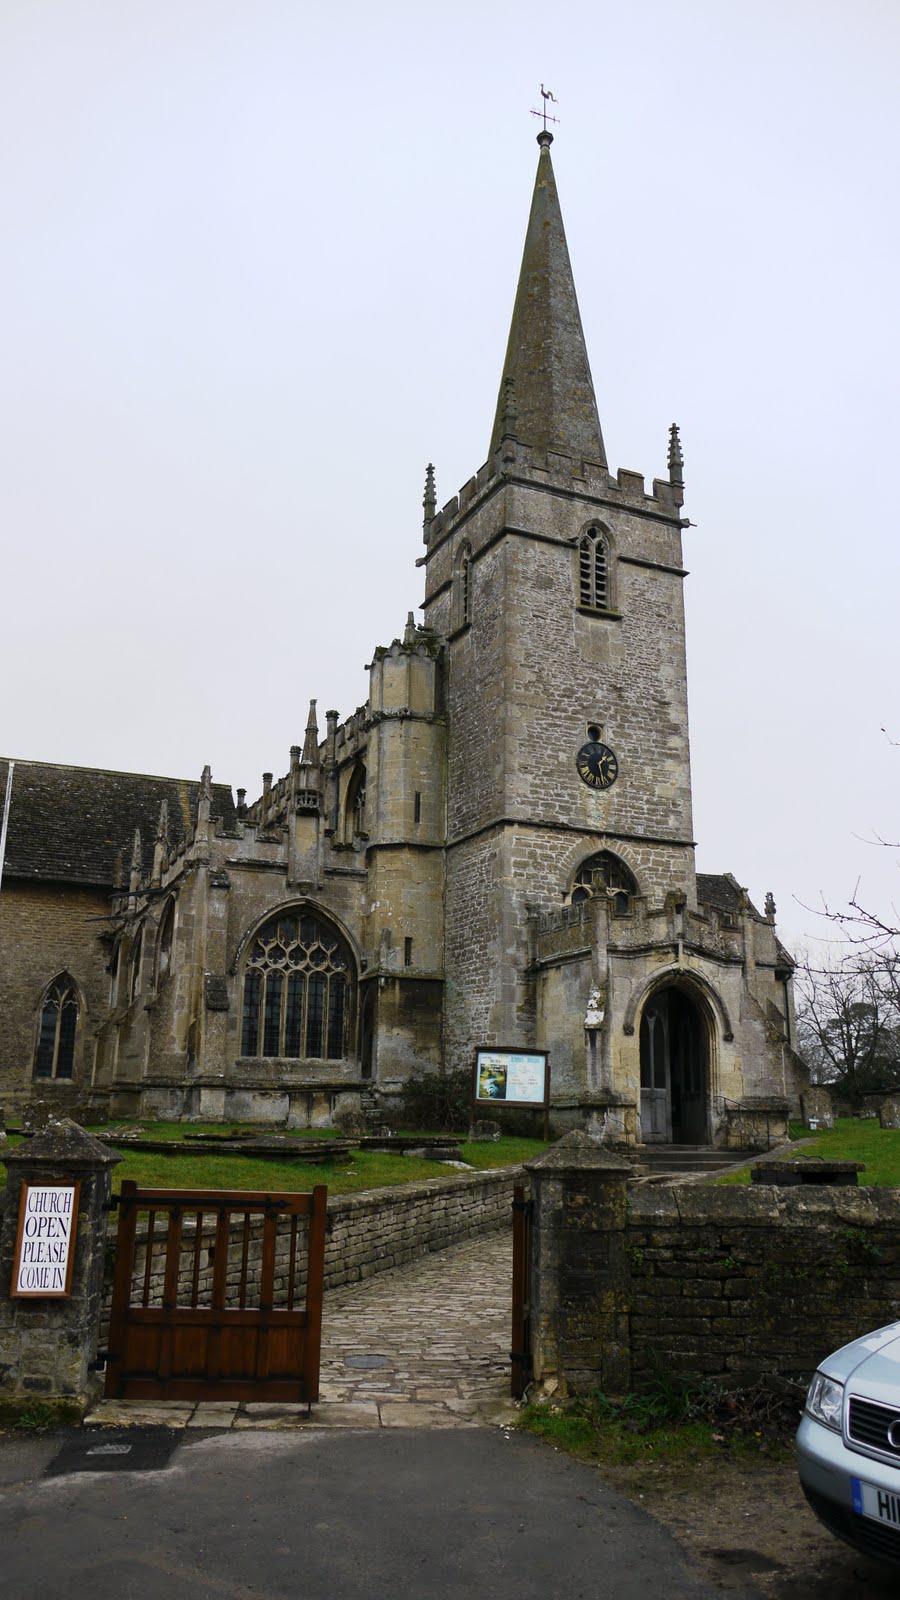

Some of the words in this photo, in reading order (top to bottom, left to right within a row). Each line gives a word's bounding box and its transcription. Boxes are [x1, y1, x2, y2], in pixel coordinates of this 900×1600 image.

[28, 1192, 72, 1213] CHURCH
[25, 1216, 69, 1237] OPEN
[22, 1241, 67, 1263] PLEASE
[20, 1267, 50, 1289] COME
[52, 1267, 65, 1289] IN
